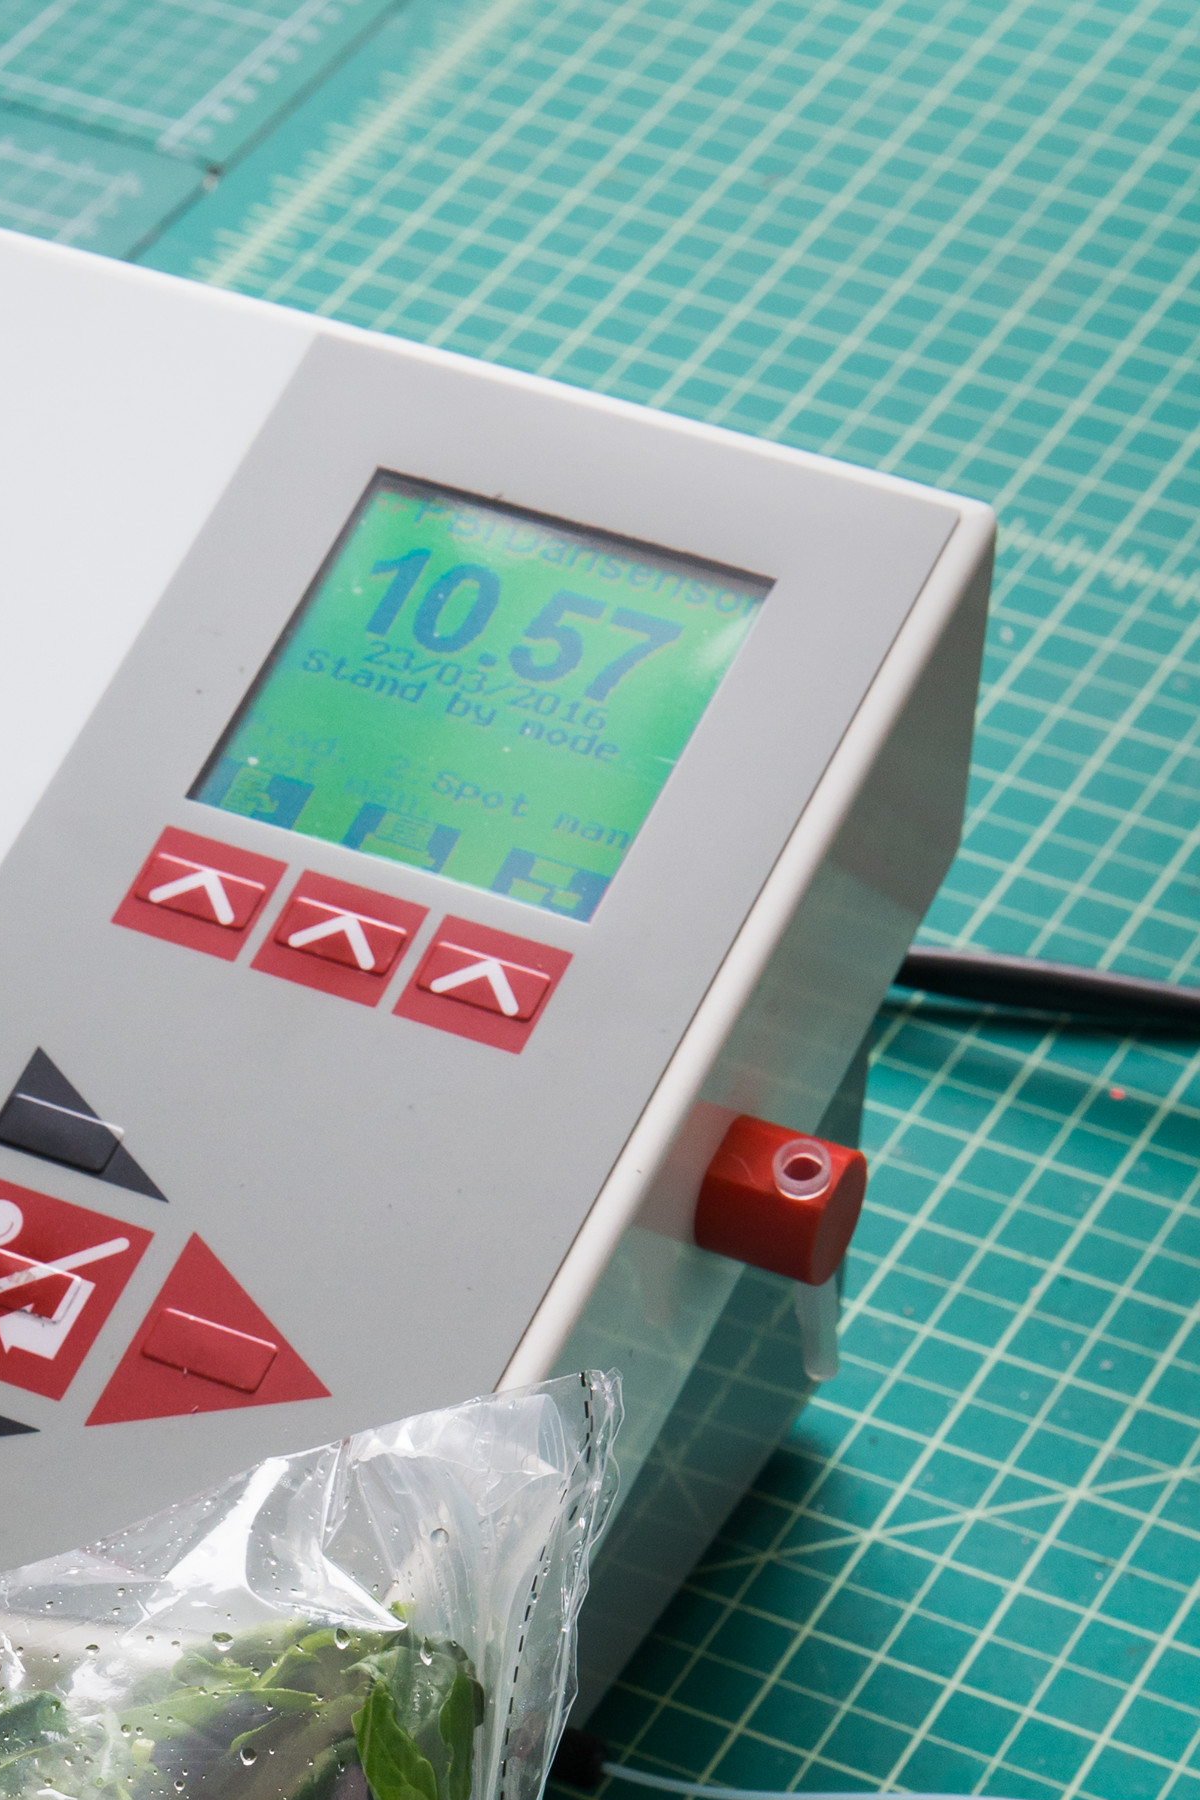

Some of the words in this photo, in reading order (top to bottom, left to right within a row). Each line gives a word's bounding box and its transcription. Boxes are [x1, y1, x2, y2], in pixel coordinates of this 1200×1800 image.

[369, 548, 683, 702] 10.57
[302, 649, 428, 704] Stand
[445, 691, 498, 728] by
[519, 719, 620, 762] mode
[362, 639, 609, 732] 23/03/2016
